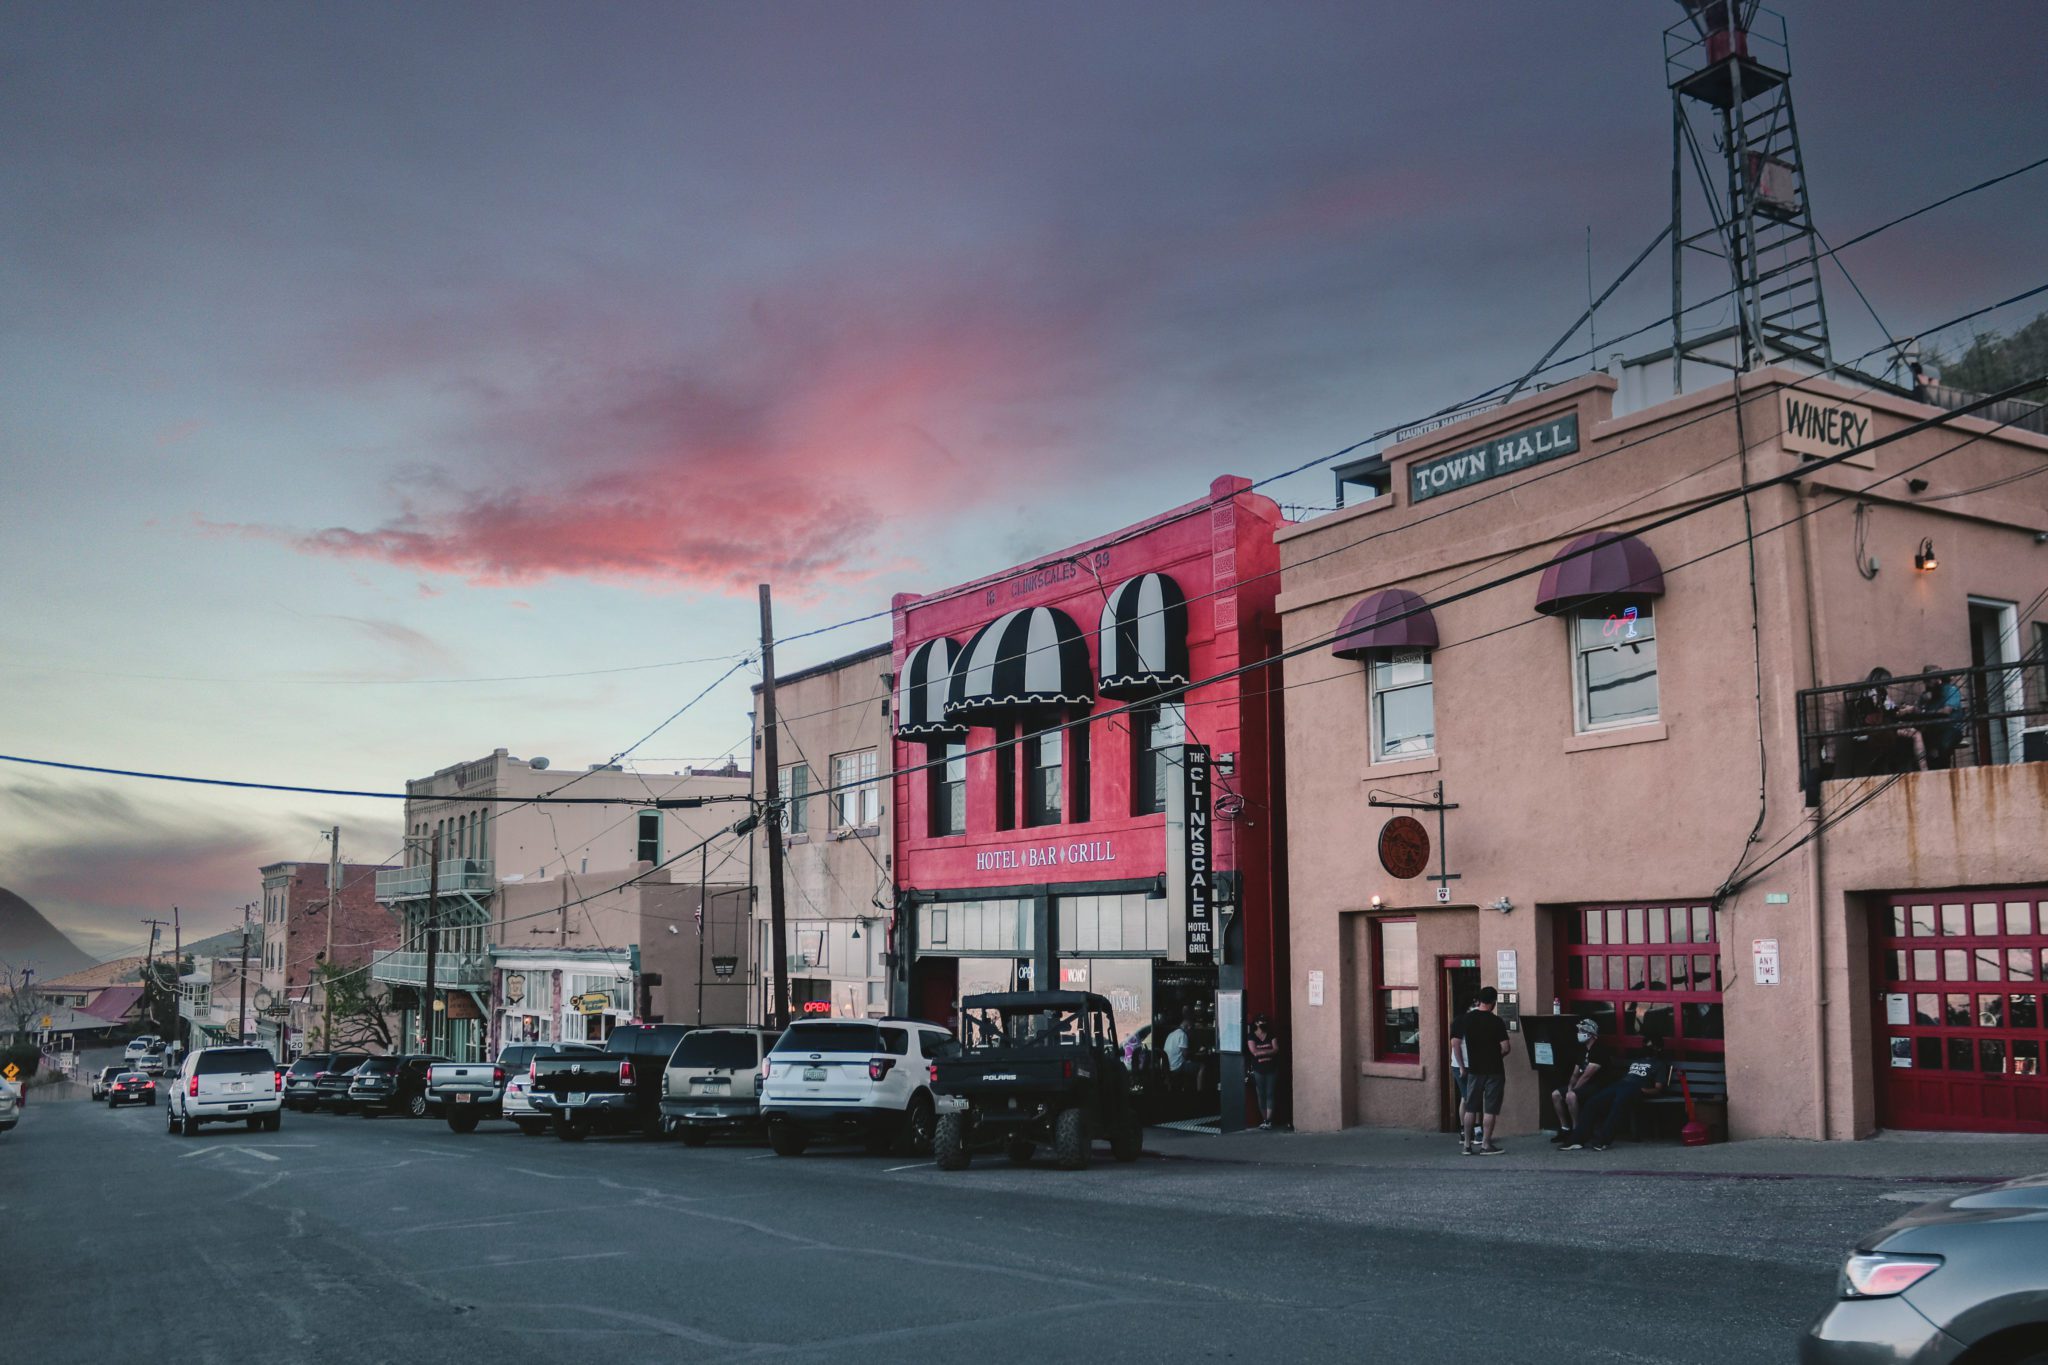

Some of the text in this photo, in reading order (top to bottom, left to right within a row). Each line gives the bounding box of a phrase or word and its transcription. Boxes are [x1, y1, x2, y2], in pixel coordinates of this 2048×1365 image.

[1786, 397, 1869, 450] WINERY
[1400, 422, 1440, 441] HAUNTED
[1416, 424, 1572, 492] TOWN HALL
[1011, 563, 1077, 598] CLINKSCALES
[1189, 752, 1205, 763] THE
[1190, 767, 1207, 918] CLINKSCALE
[976, 841, 1116, 871] HOTEL BAR GRILL
[1187, 922, 1211, 932] HOTEL
[1191, 933, 1207, 942] BAR
[1189, 944, 1210, 953] GRILL
[1759, 956, 1773, 965] ANY
[1759, 967, 1775, 976] TIME
[803, 1002, 830, 1013] OPEN
[291, 1041, 303, 1049] 20
